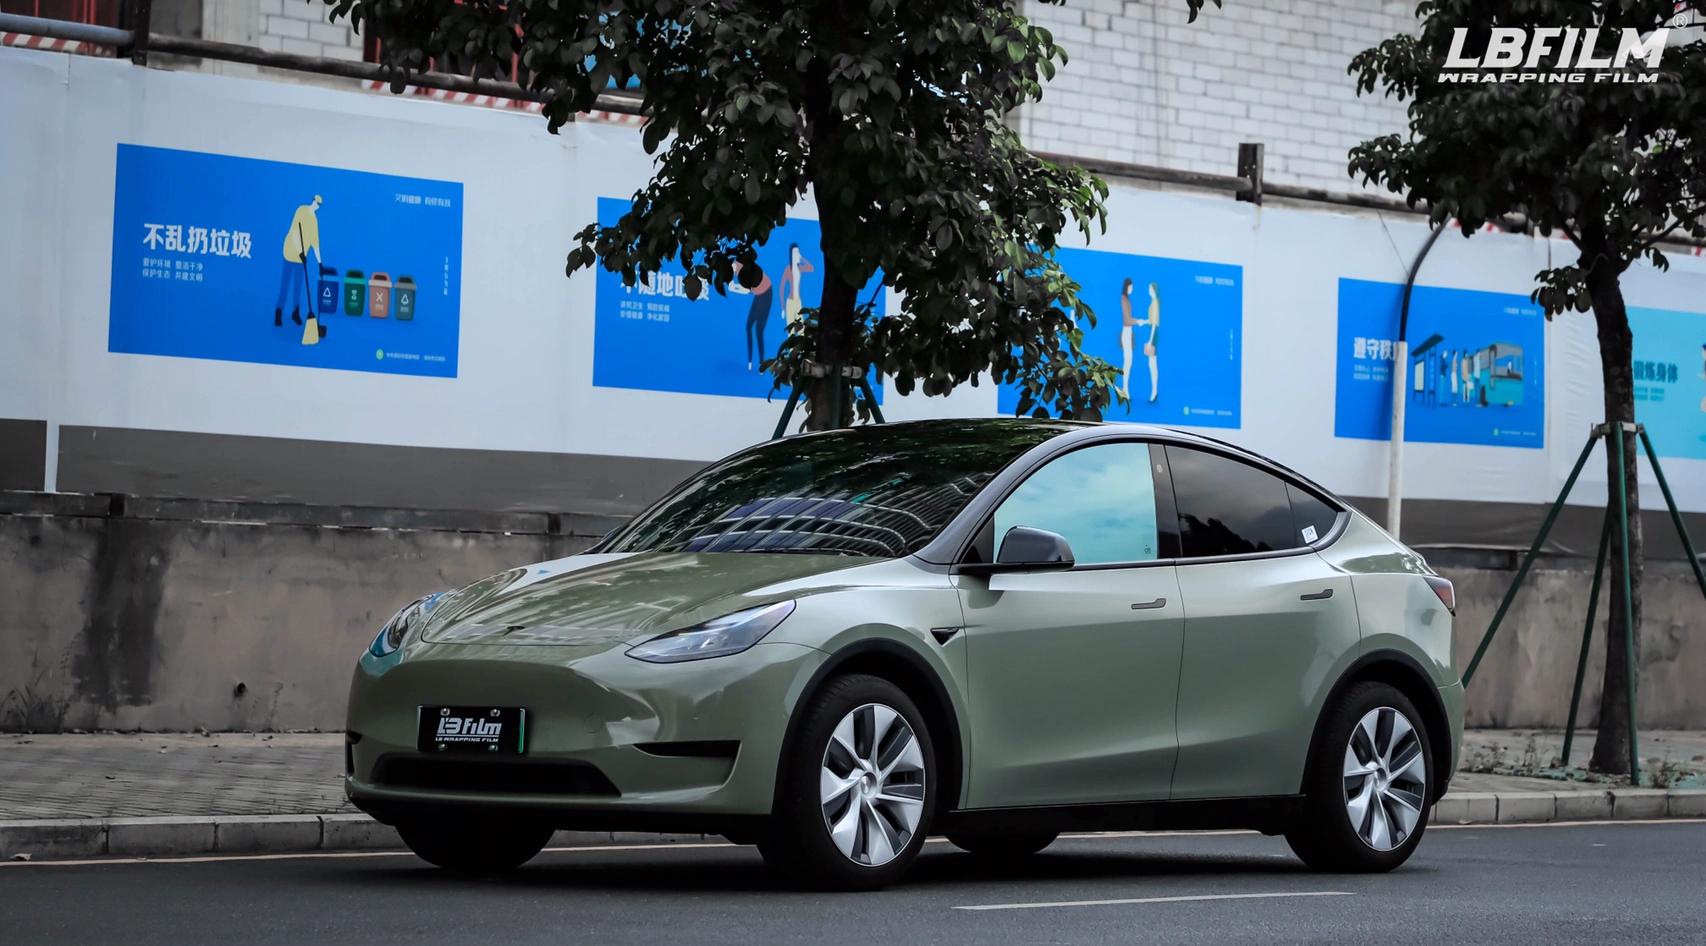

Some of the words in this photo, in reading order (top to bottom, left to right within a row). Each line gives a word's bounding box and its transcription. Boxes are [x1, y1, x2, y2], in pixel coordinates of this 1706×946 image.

[143, 223, 252, 259] 不乱扔垃圾
